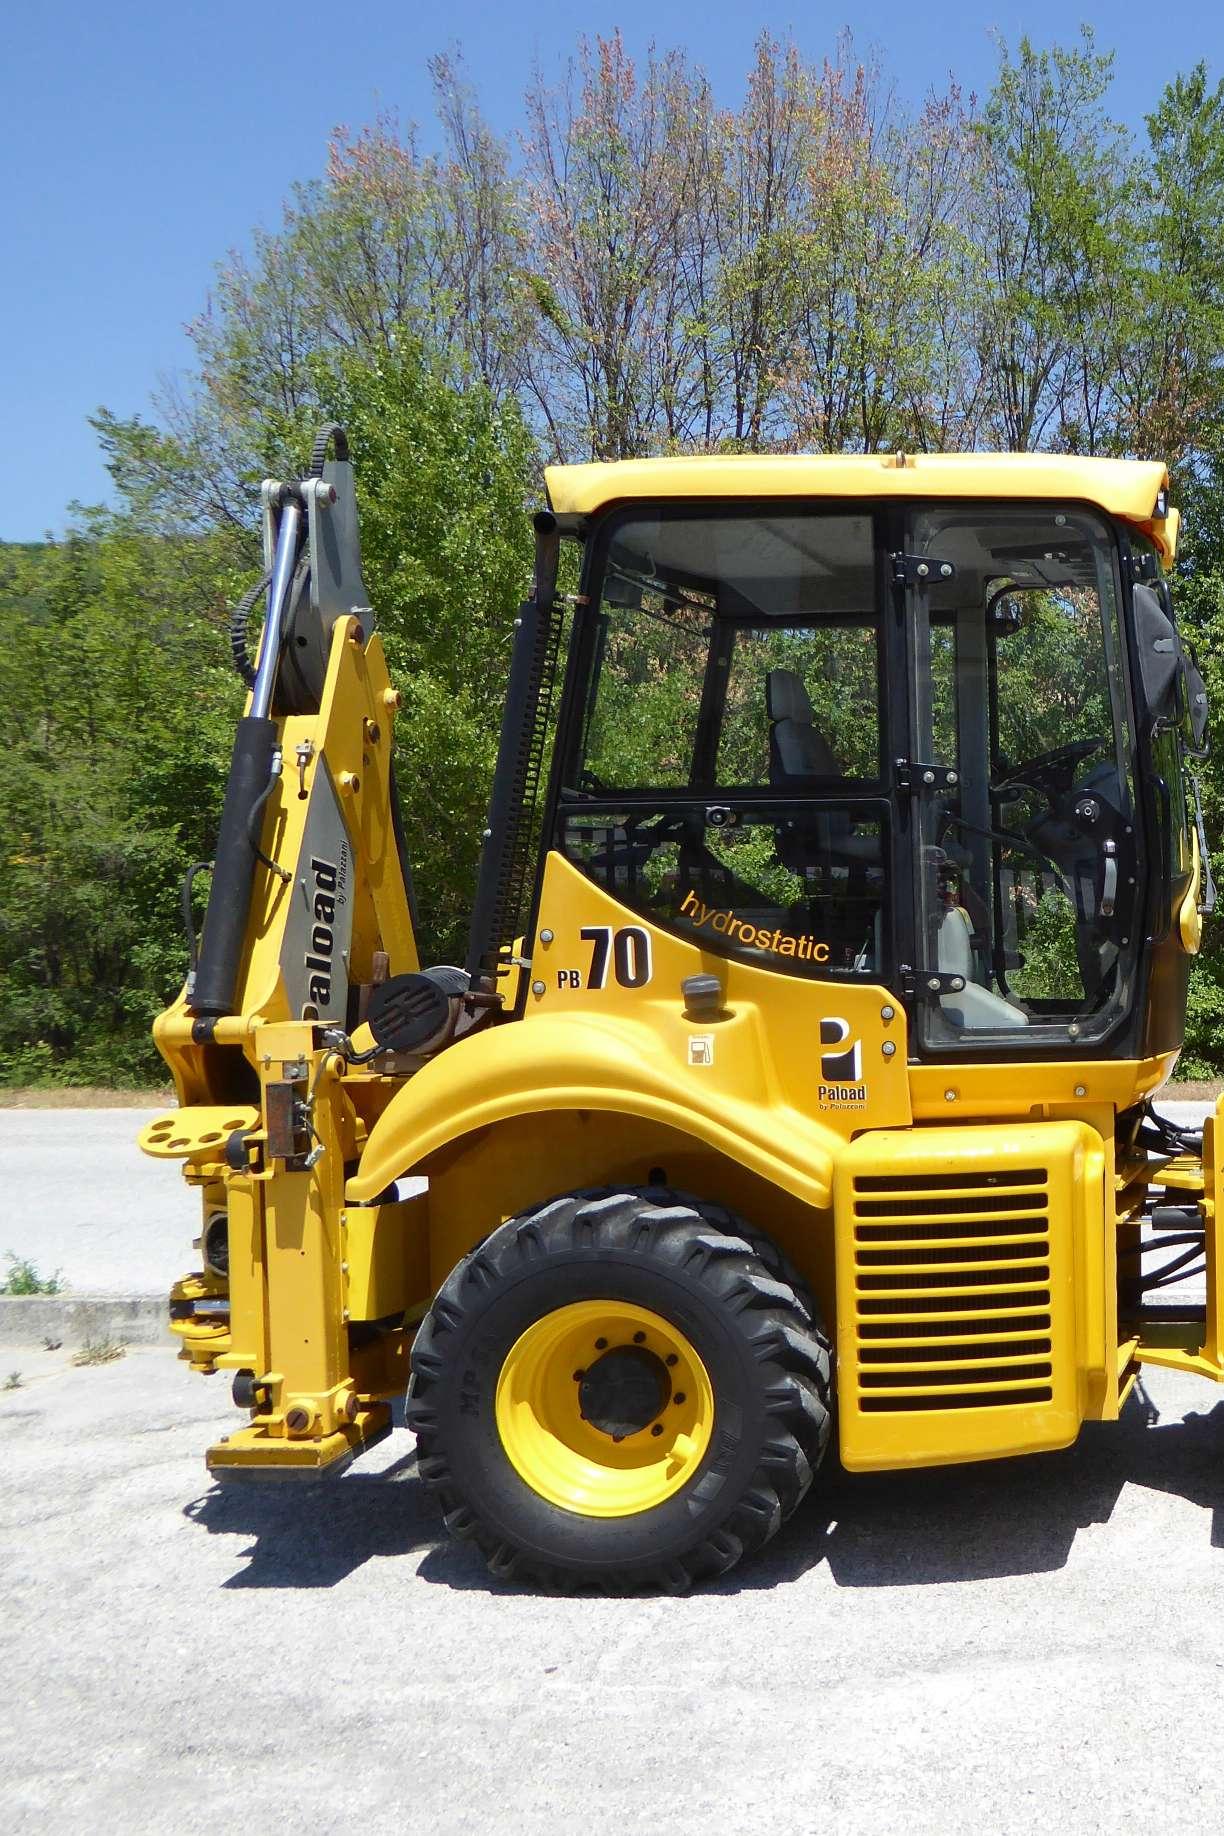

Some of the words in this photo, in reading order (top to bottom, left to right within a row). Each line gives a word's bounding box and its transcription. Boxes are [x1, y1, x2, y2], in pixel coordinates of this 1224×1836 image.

[557, 970, 581, 989] PB
[580, 925, 653, 990] 70
[680, 889, 830, 962] hydrostatic
[817, 1084, 866, 1101] Paload
